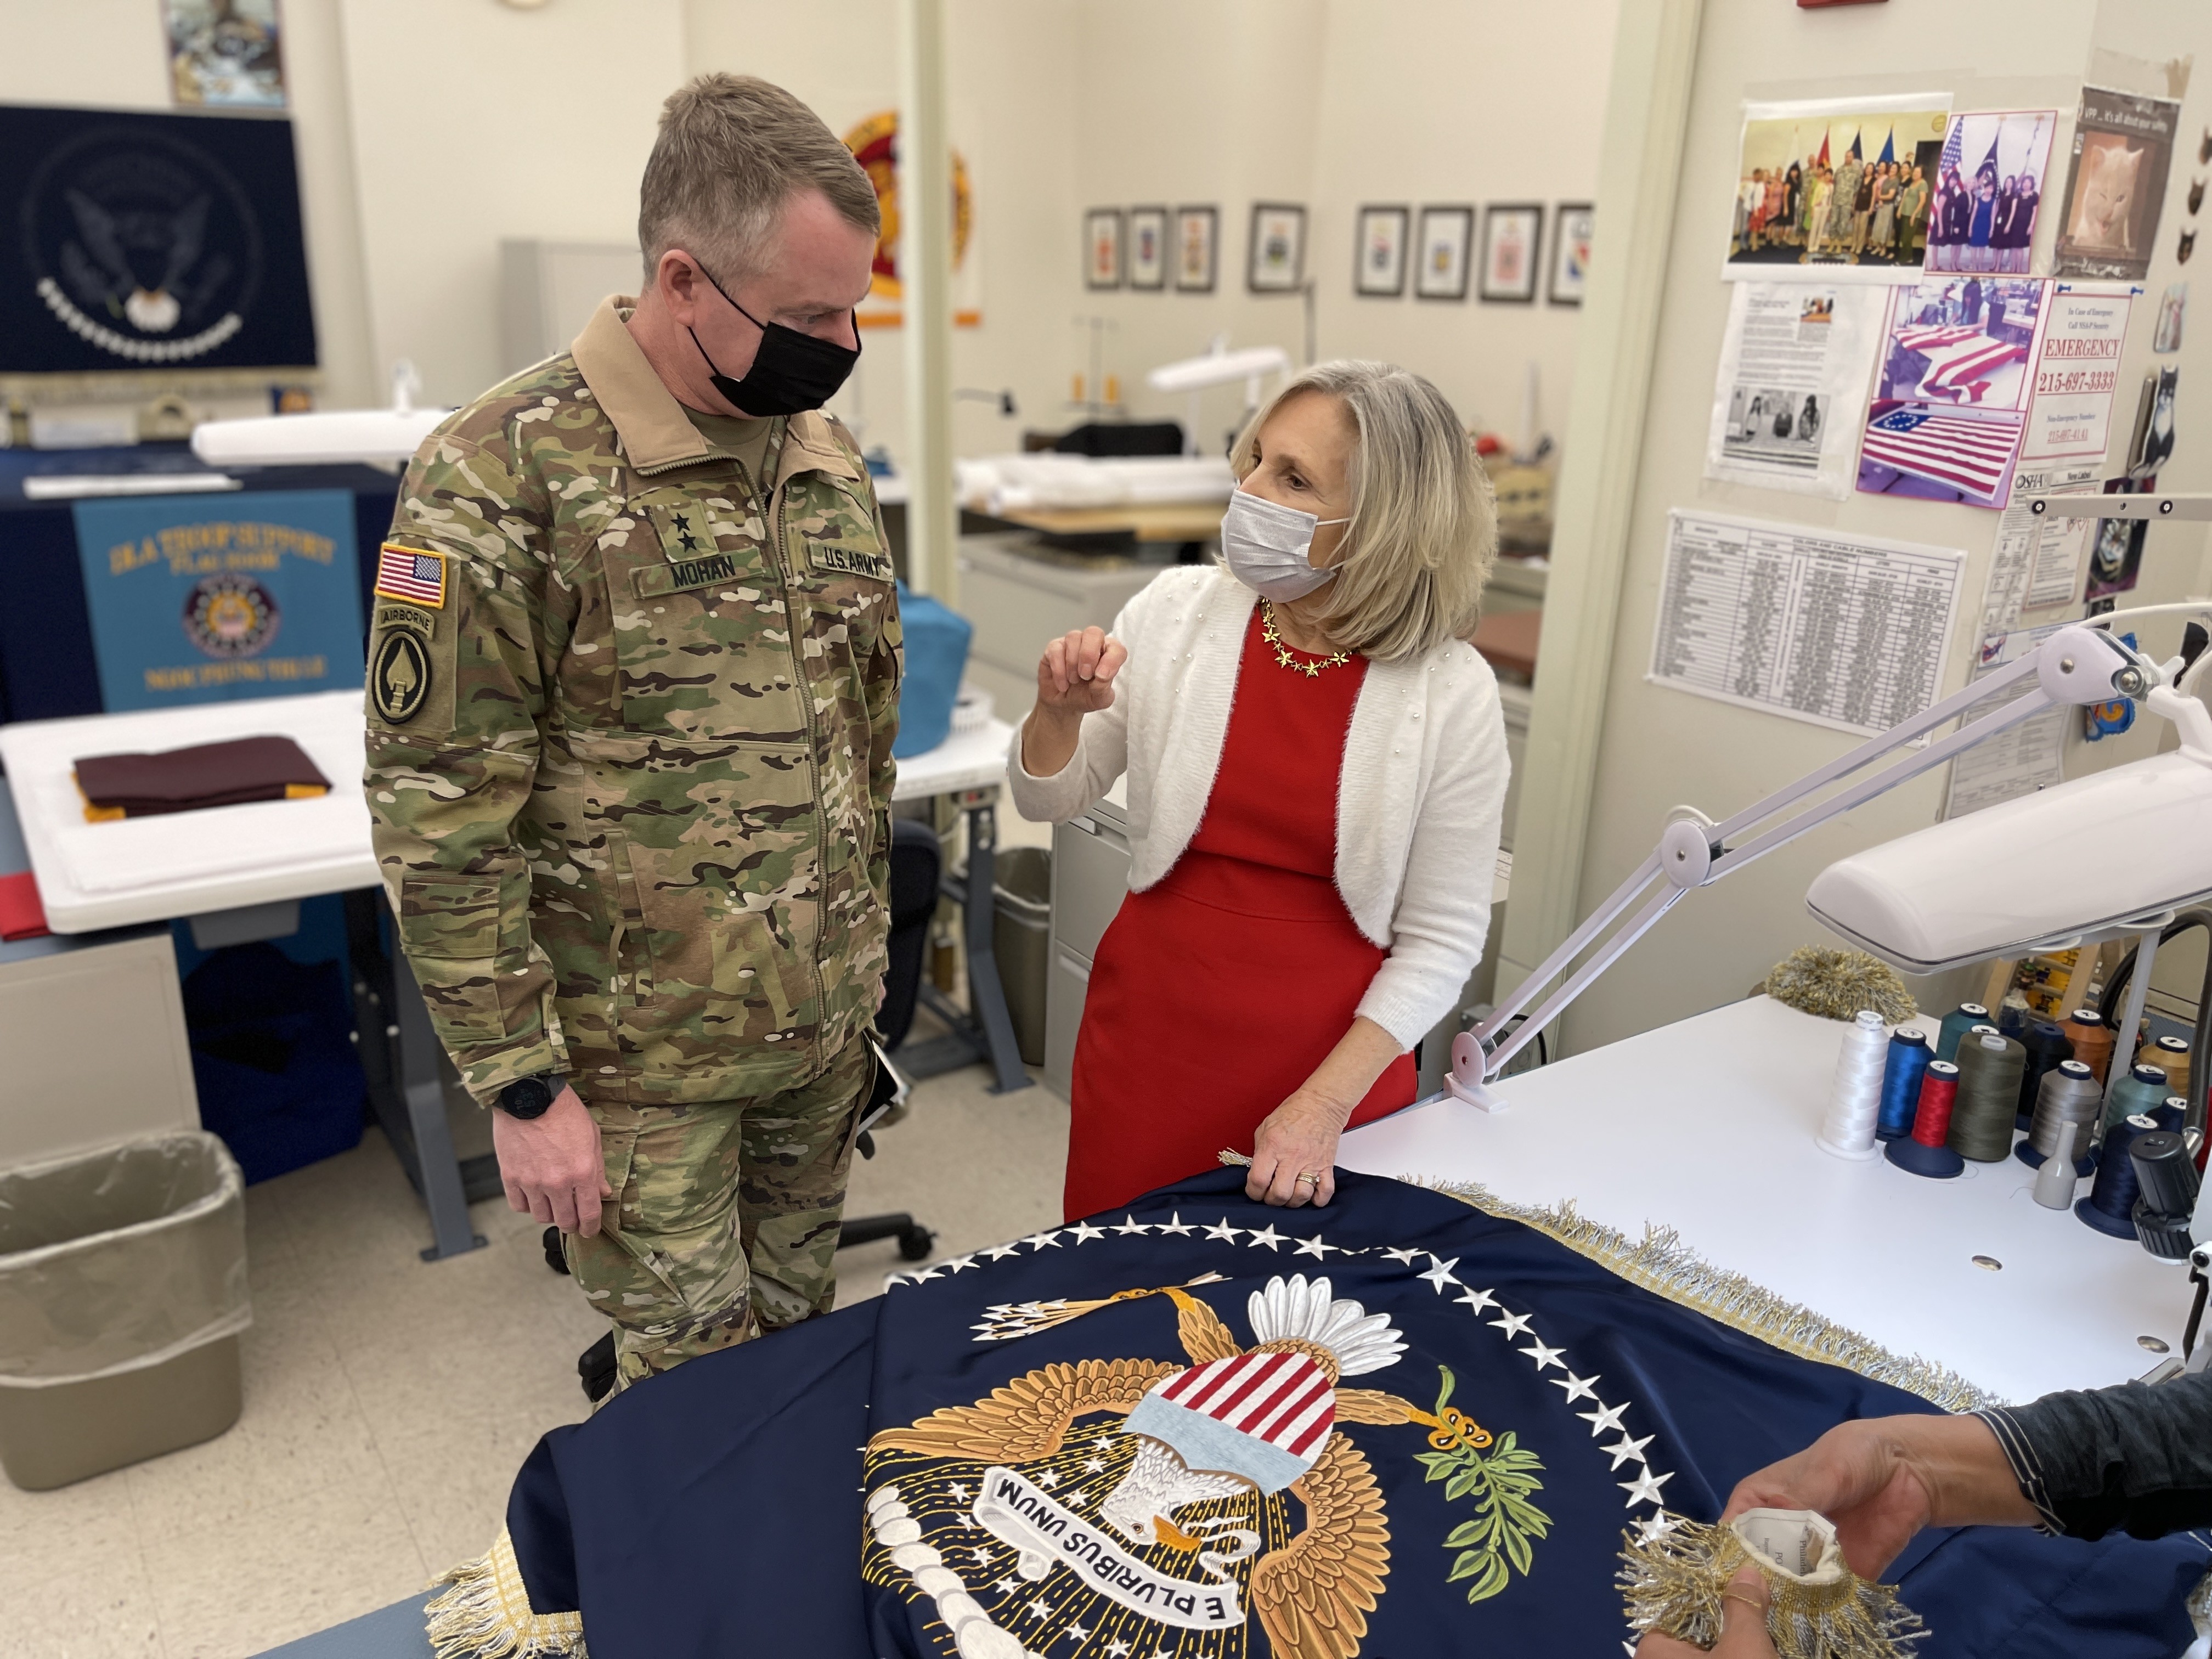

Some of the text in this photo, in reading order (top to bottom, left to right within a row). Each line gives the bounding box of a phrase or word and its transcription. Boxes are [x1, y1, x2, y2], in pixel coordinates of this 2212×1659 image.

[2114, 112, 2123, 124] all
[2045, 338, 2120, 357] EMERGENCY
[2038, 371, 2114, 392] 215-697-3333
[2015, 473, 2043, 489] OSHA
[2067, 470, 2091, 481] New Label
[670, 556, 736, 588] MOHAN
[849, 551, 879, 577] ARMY
[381, 608, 430, 631] AIRBORNE
[996, 1478, 1226, 1621] E PLURIBUS UNUM
